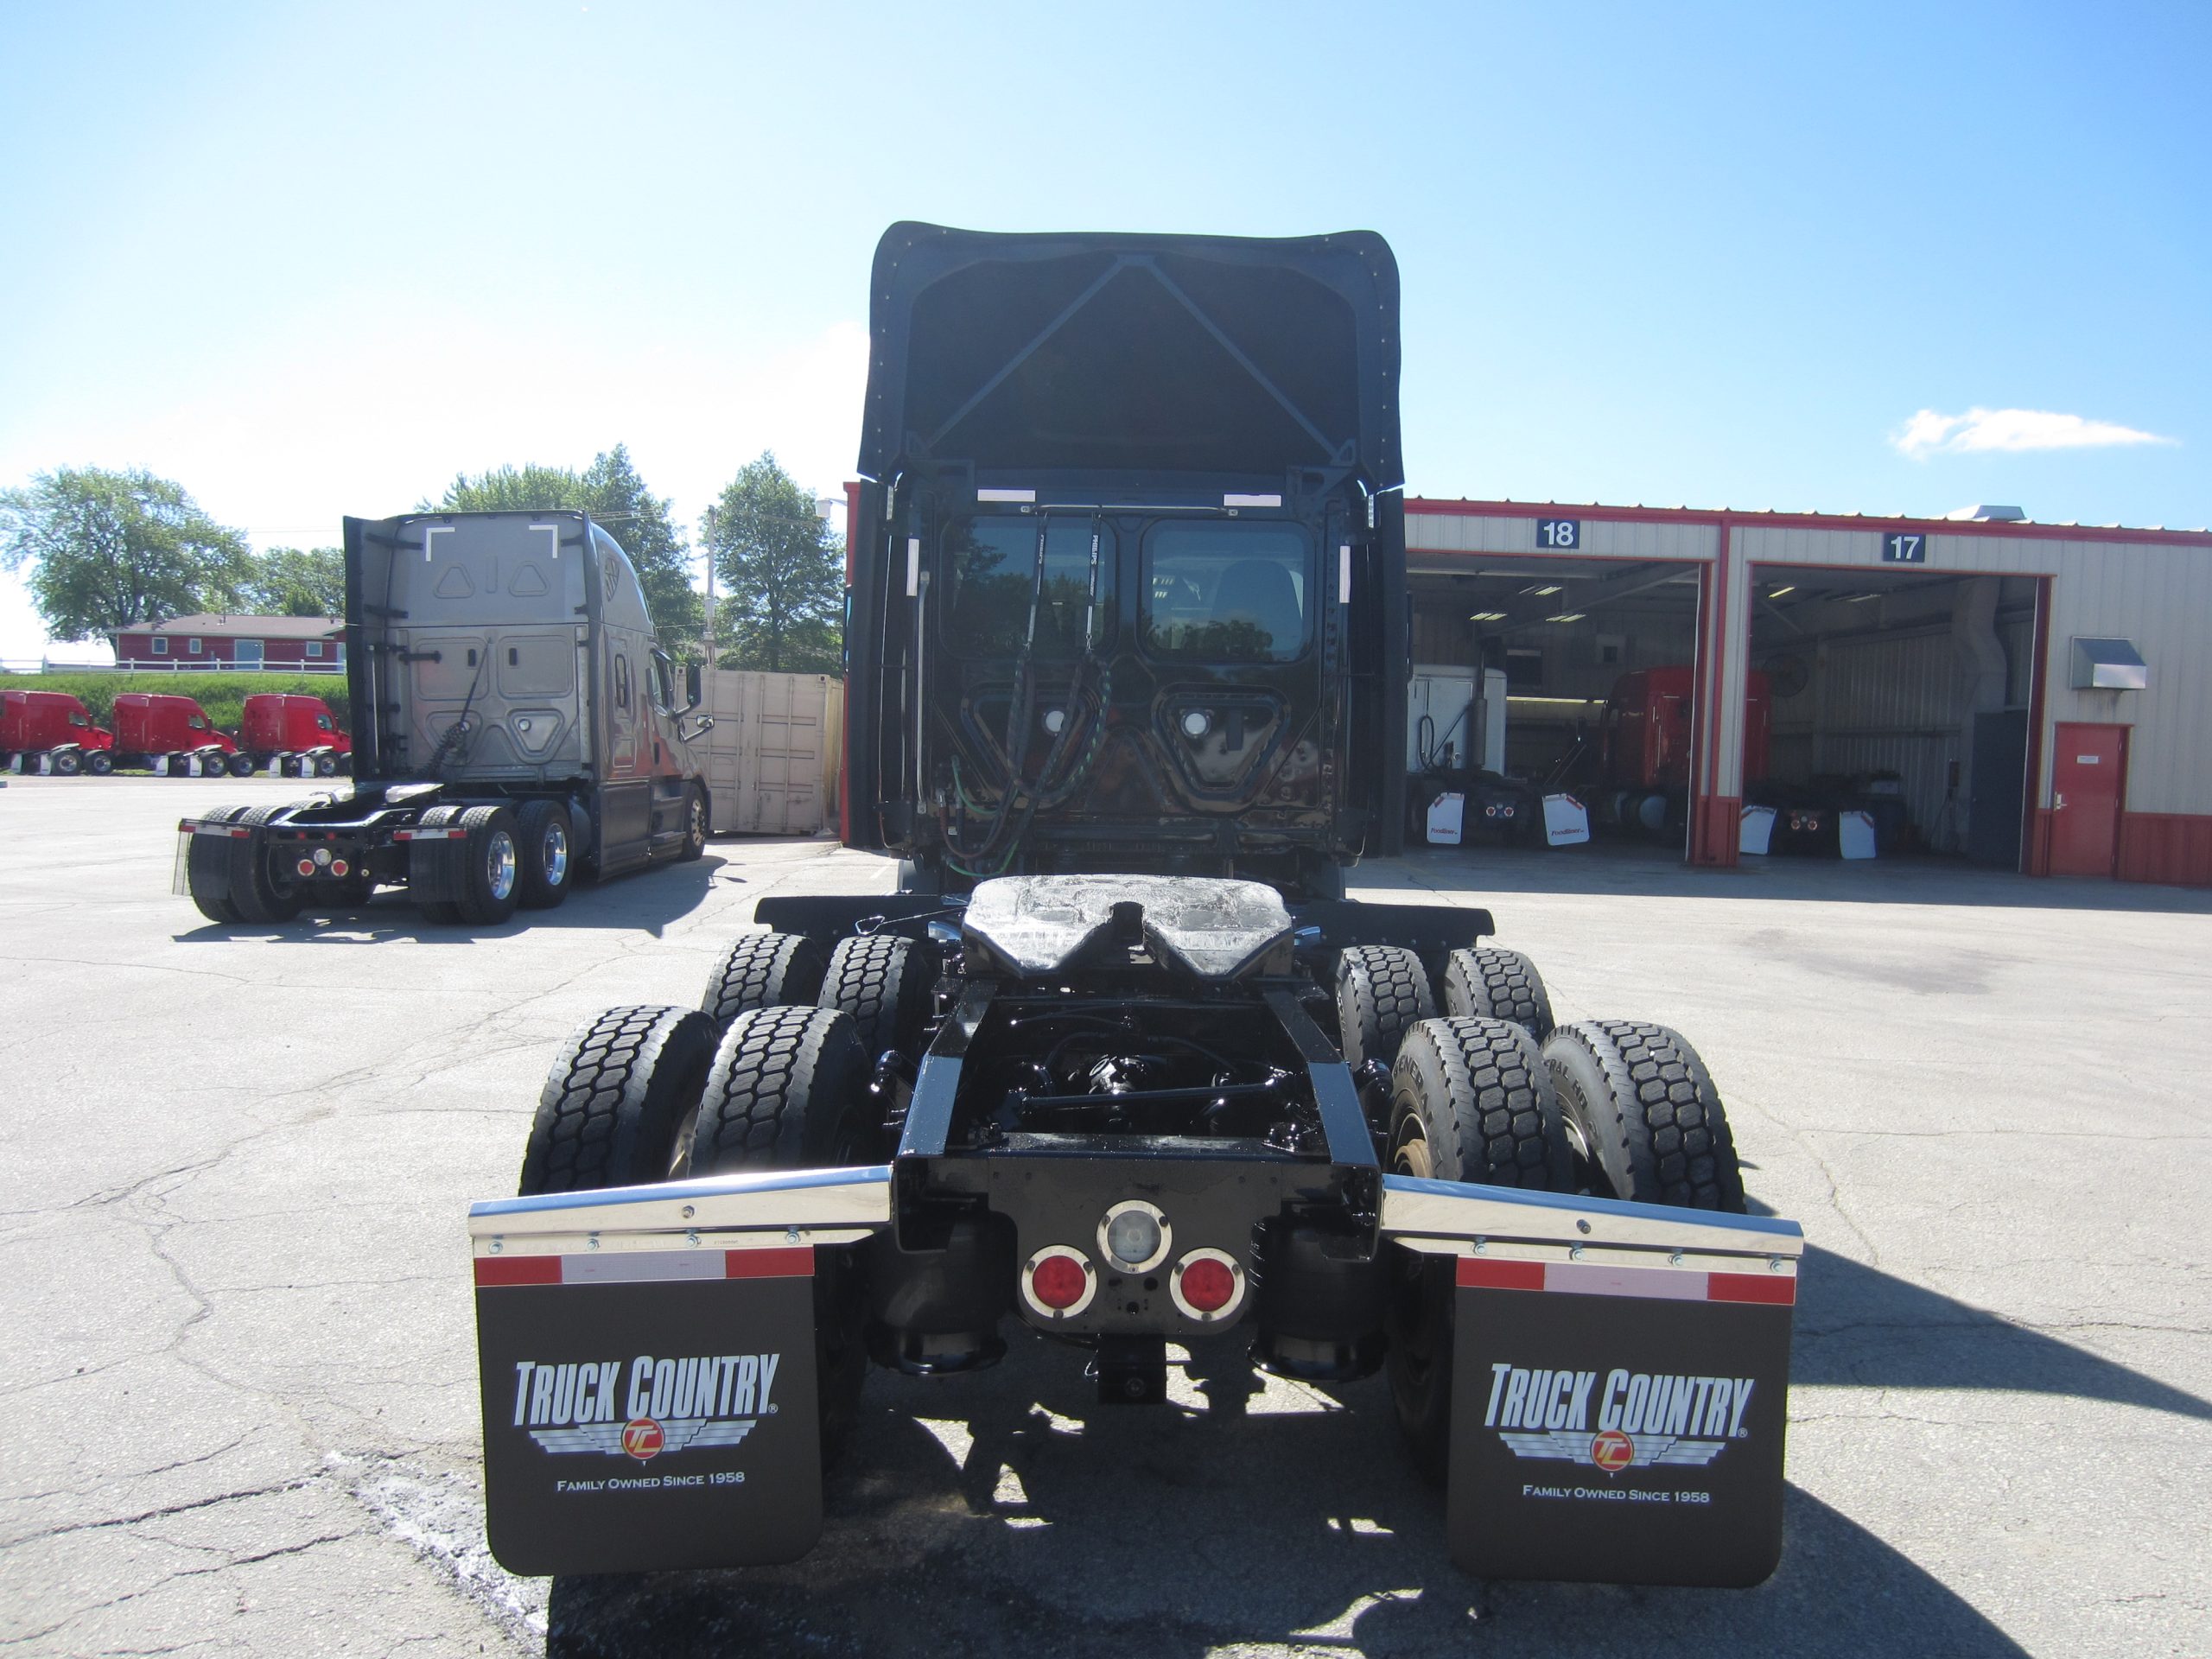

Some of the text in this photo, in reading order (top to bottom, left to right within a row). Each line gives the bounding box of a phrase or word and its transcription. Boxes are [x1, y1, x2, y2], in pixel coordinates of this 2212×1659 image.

[1543, 522, 1573, 546] 18
[1891, 536, 1919, 560] 17
[513, 1360, 622, 1426] TRUCK
[1484, 1363, 1597, 1431] TRUCK
[556, 1471, 746, 1492] FAMILY OWNED SINCE 1958
[1522, 1484, 1710, 1503] FAMILY OWNED SINCE 1958
